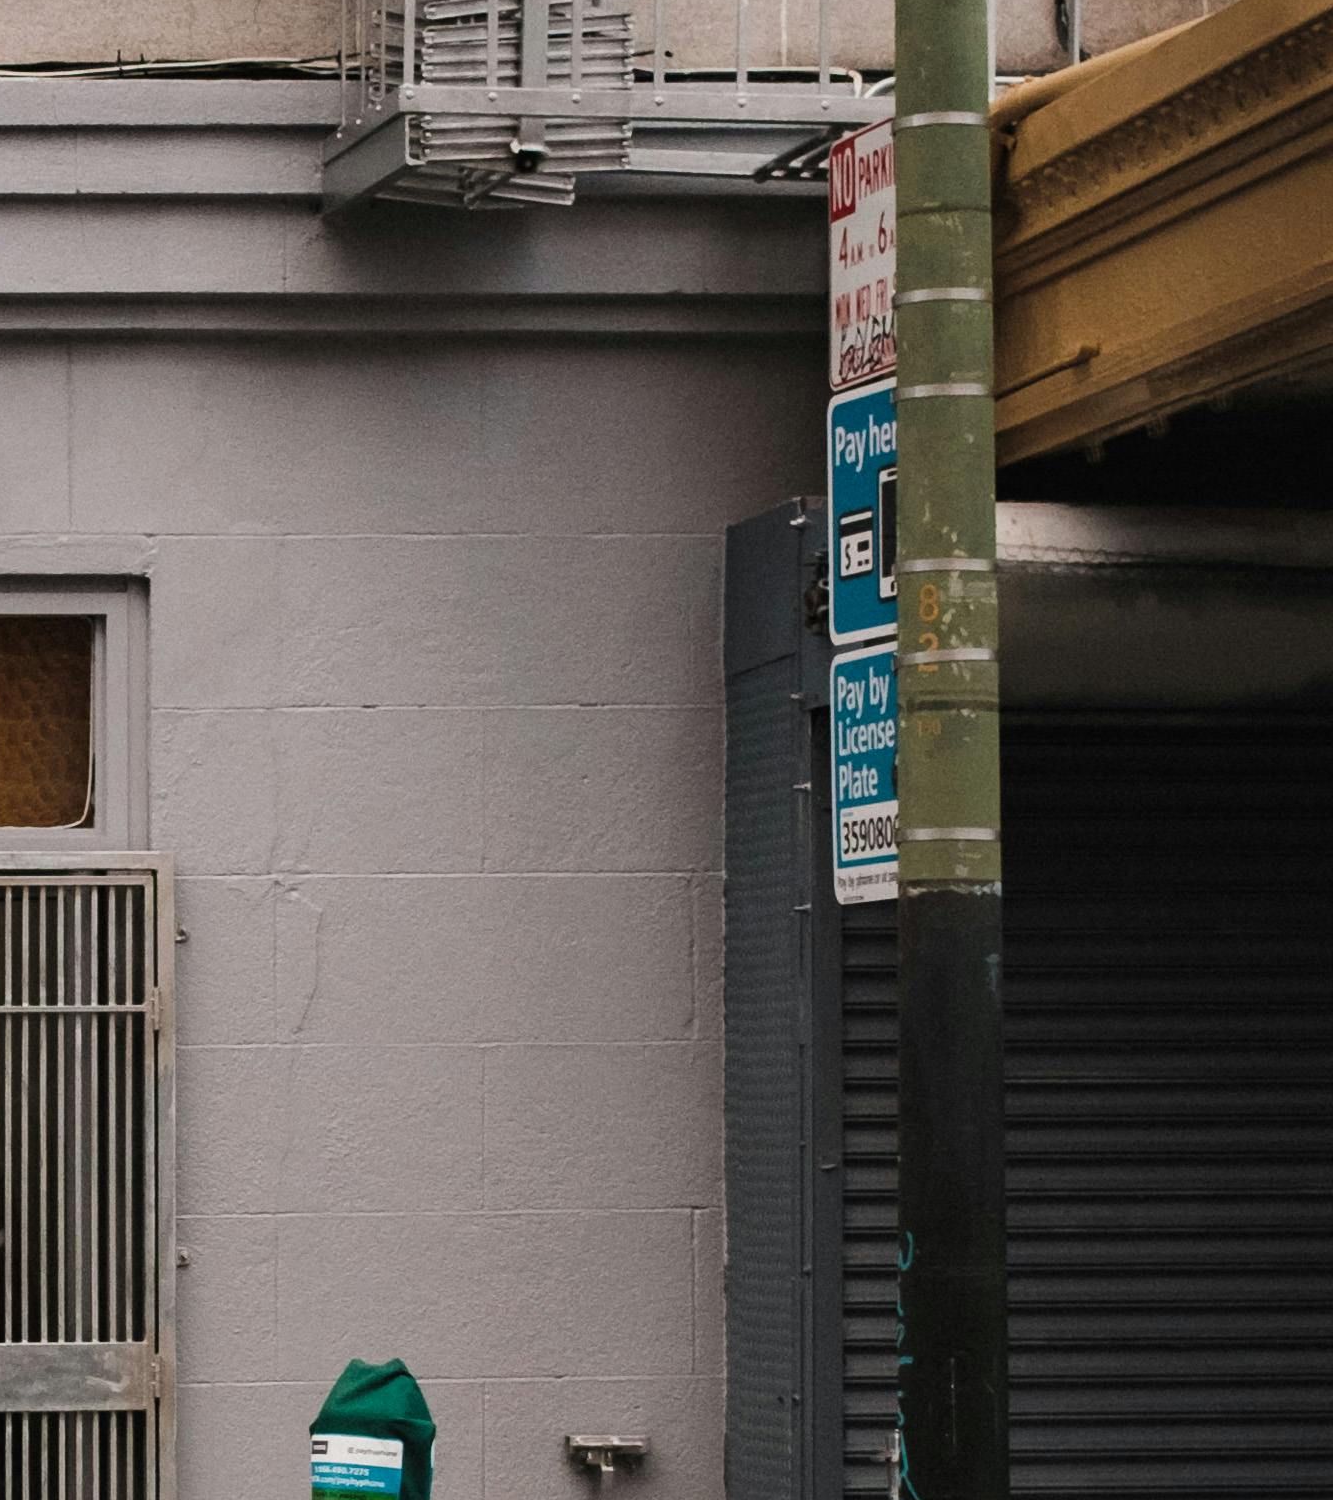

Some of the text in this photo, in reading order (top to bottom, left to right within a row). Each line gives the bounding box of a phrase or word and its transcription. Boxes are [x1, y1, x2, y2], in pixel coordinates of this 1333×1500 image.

[831, 143, 895, 213] NO PARKI
[834, 413, 897, 473] Pay her
[837, 666, 890, 720] Pay by
[838, 717, 896, 758] License
[839, 764, 879, 802] Plate
